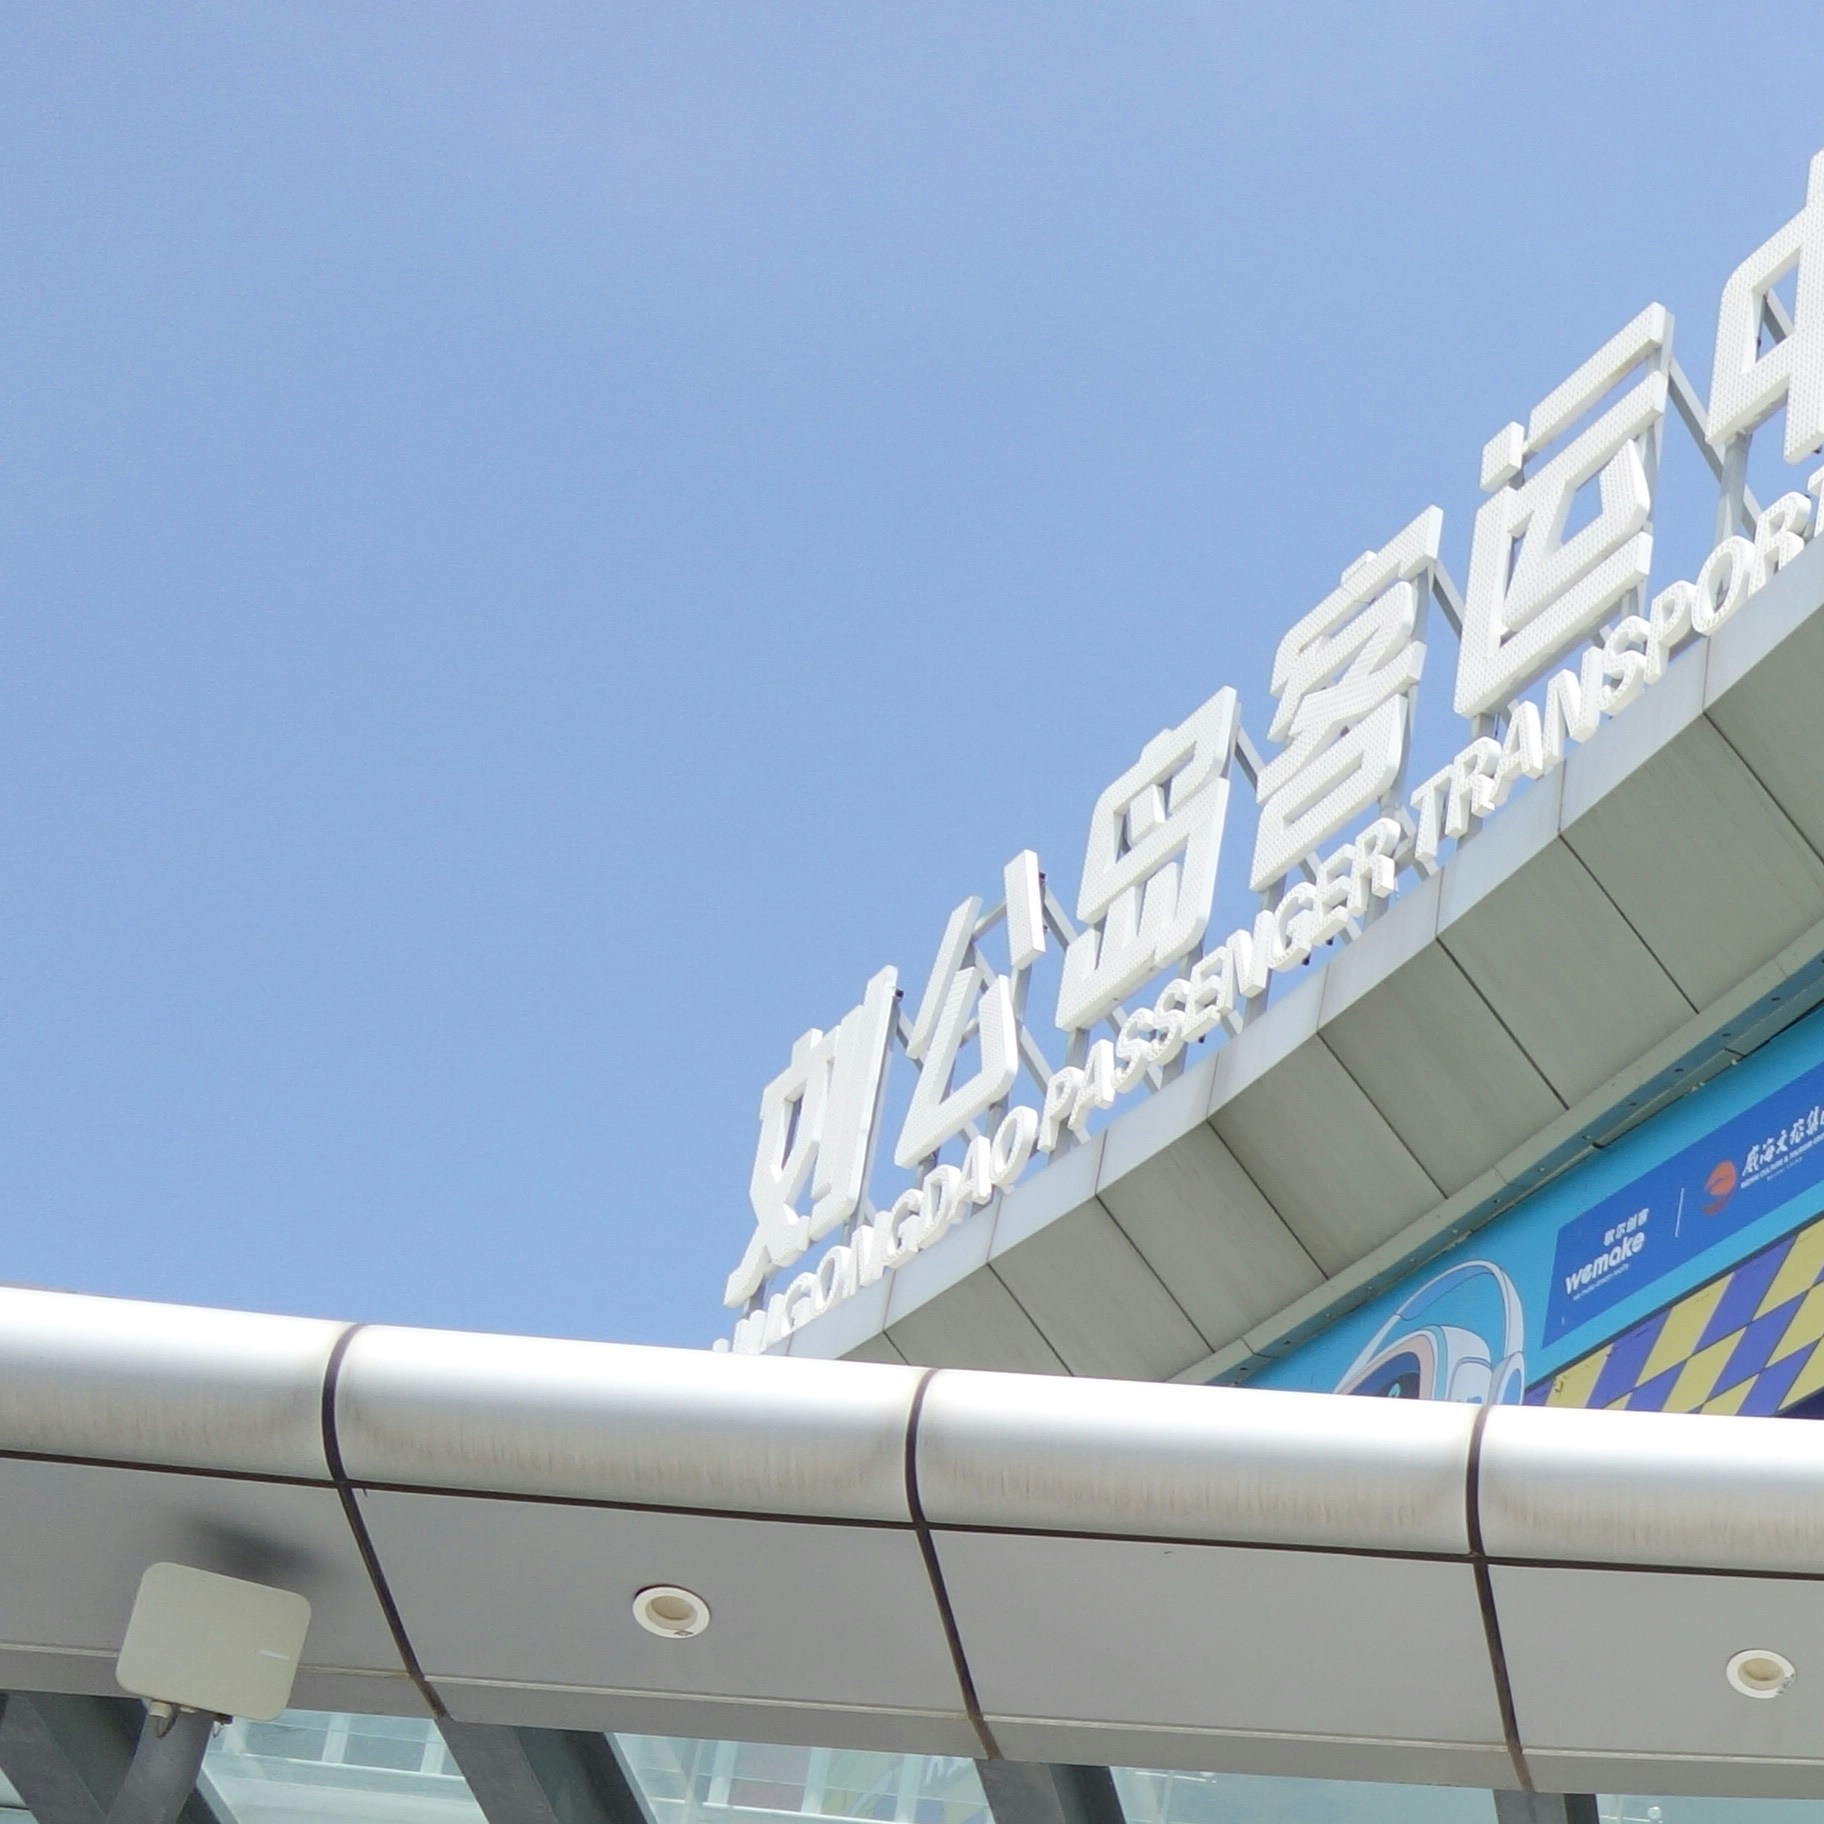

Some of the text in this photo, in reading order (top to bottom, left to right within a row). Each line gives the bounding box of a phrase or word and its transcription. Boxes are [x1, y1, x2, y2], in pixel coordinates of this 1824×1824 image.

[712, 1105, 1038, 1356] GONGDAO
[1037, 817, 1400, 1153] PASSENGER
[1565, 1231, 1646, 1294] wemake
